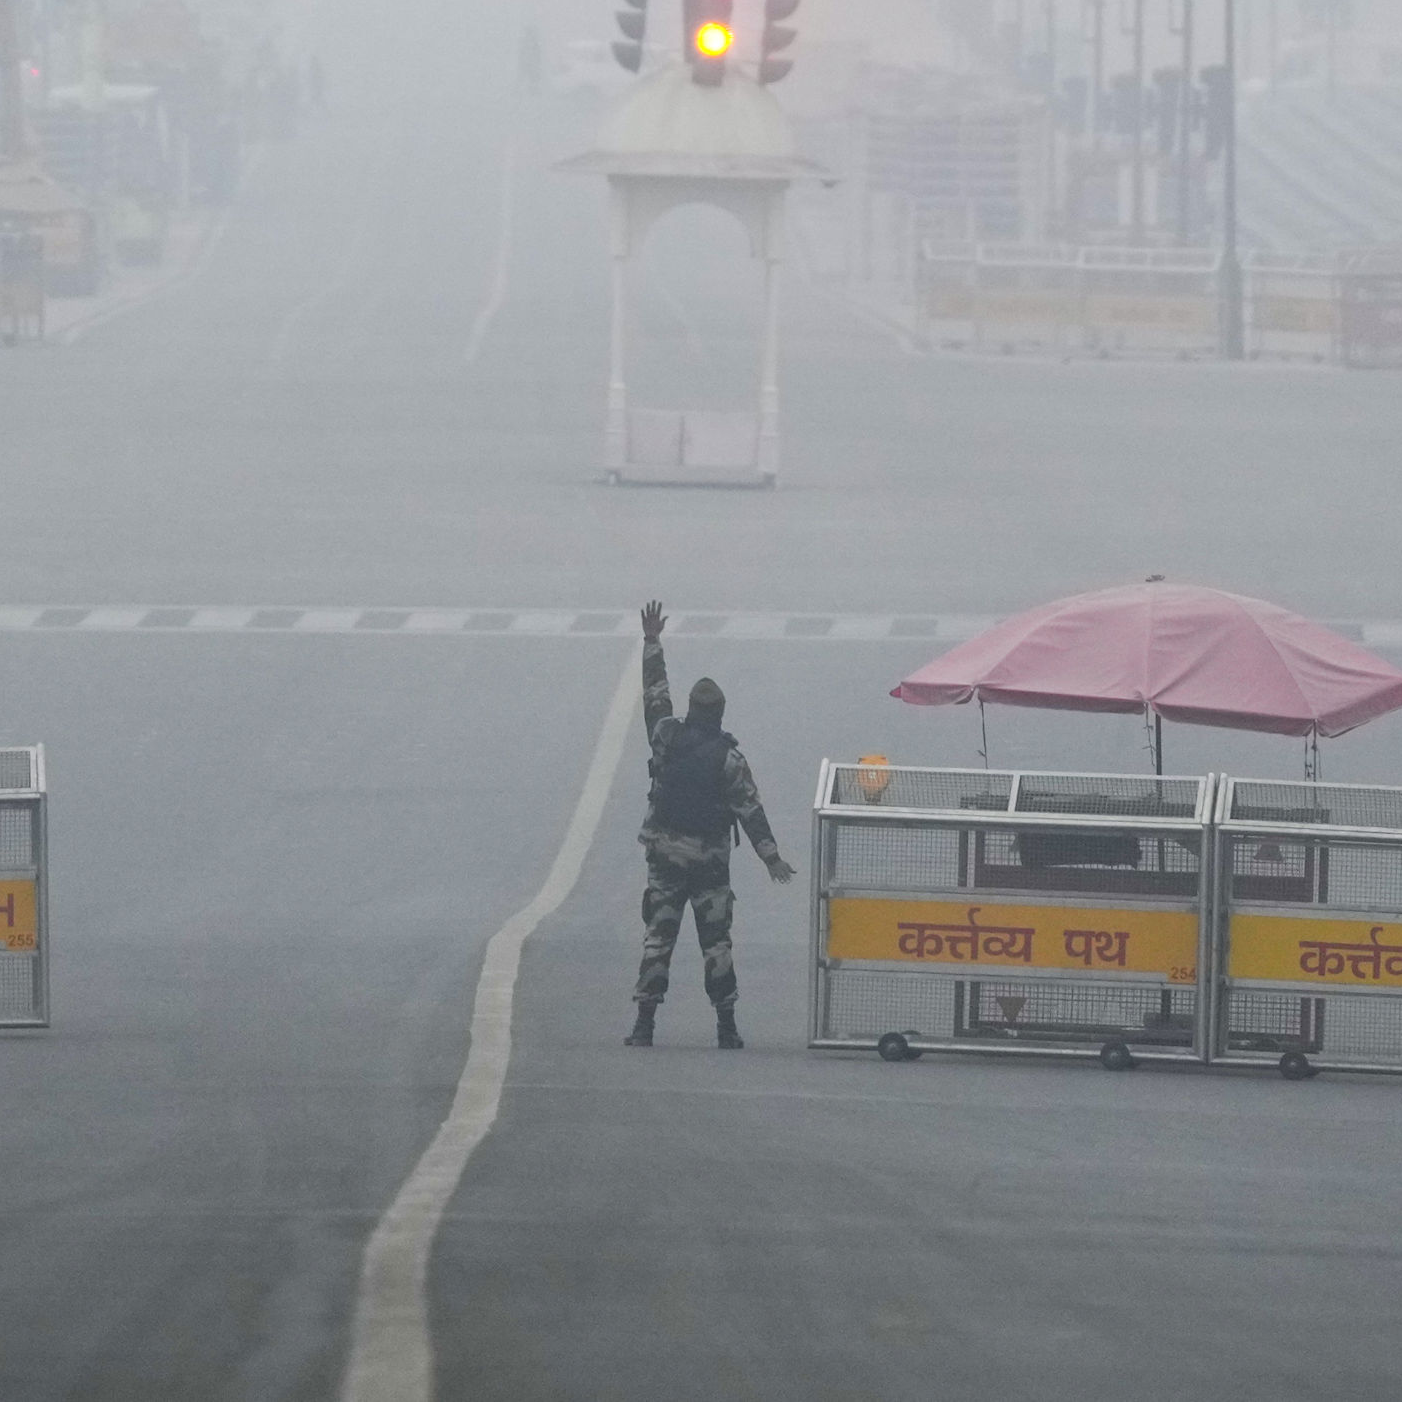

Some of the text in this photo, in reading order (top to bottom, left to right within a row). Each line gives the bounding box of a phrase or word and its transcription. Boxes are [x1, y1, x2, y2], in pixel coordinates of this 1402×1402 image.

[8, 934, 34, 947] 255
[1064, 930, 1130, 967] पथ
[1170, 966, 1197, 980] 254
